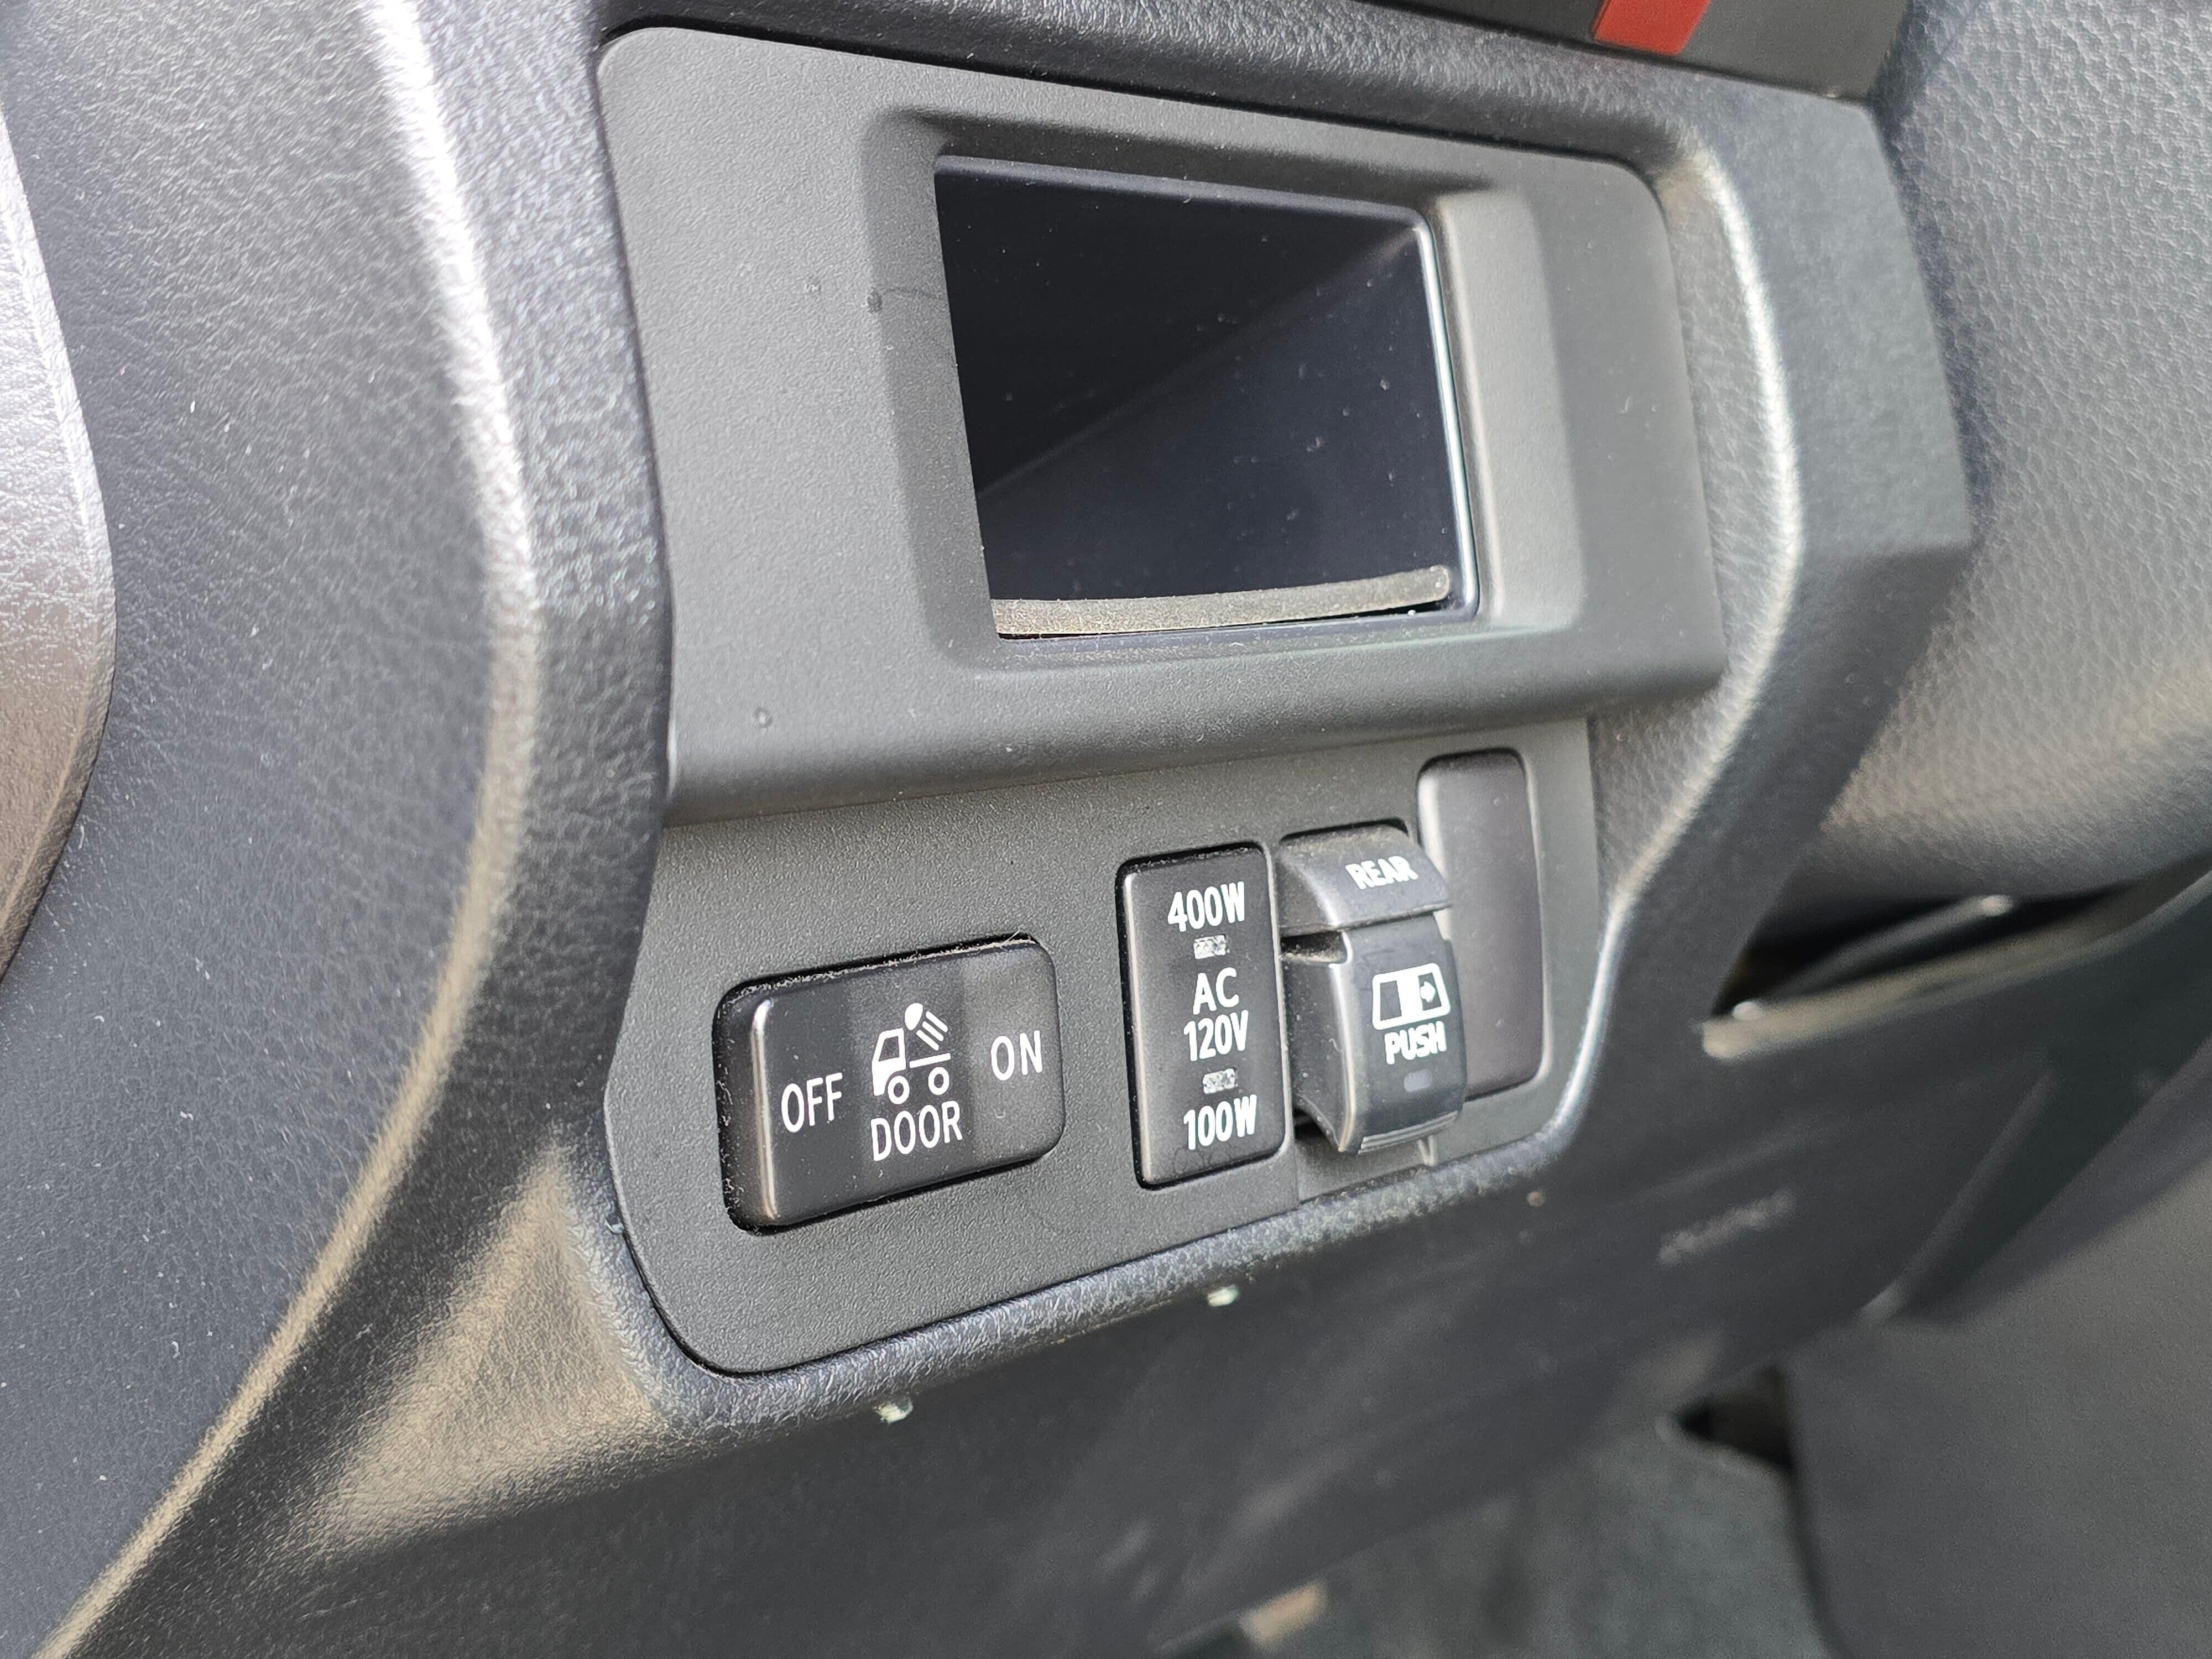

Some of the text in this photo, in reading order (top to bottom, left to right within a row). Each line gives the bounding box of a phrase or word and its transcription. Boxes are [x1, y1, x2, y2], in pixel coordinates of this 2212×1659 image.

[1345, 855, 1419, 890] REAR
[1167, 881, 1245, 932] 400W
[1193, 967, 1239, 1015] AC
[990, 1030, 1043, 1081] ON
[1183, 1009, 1249, 1061] 120V
[1384, 1020, 1447, 1065] PUSH
[781, 1072, 843, 1133] OFF
[1183, 1094, 1258, 1150] 100W
[870, 1100, 963, 1162] DOOR
